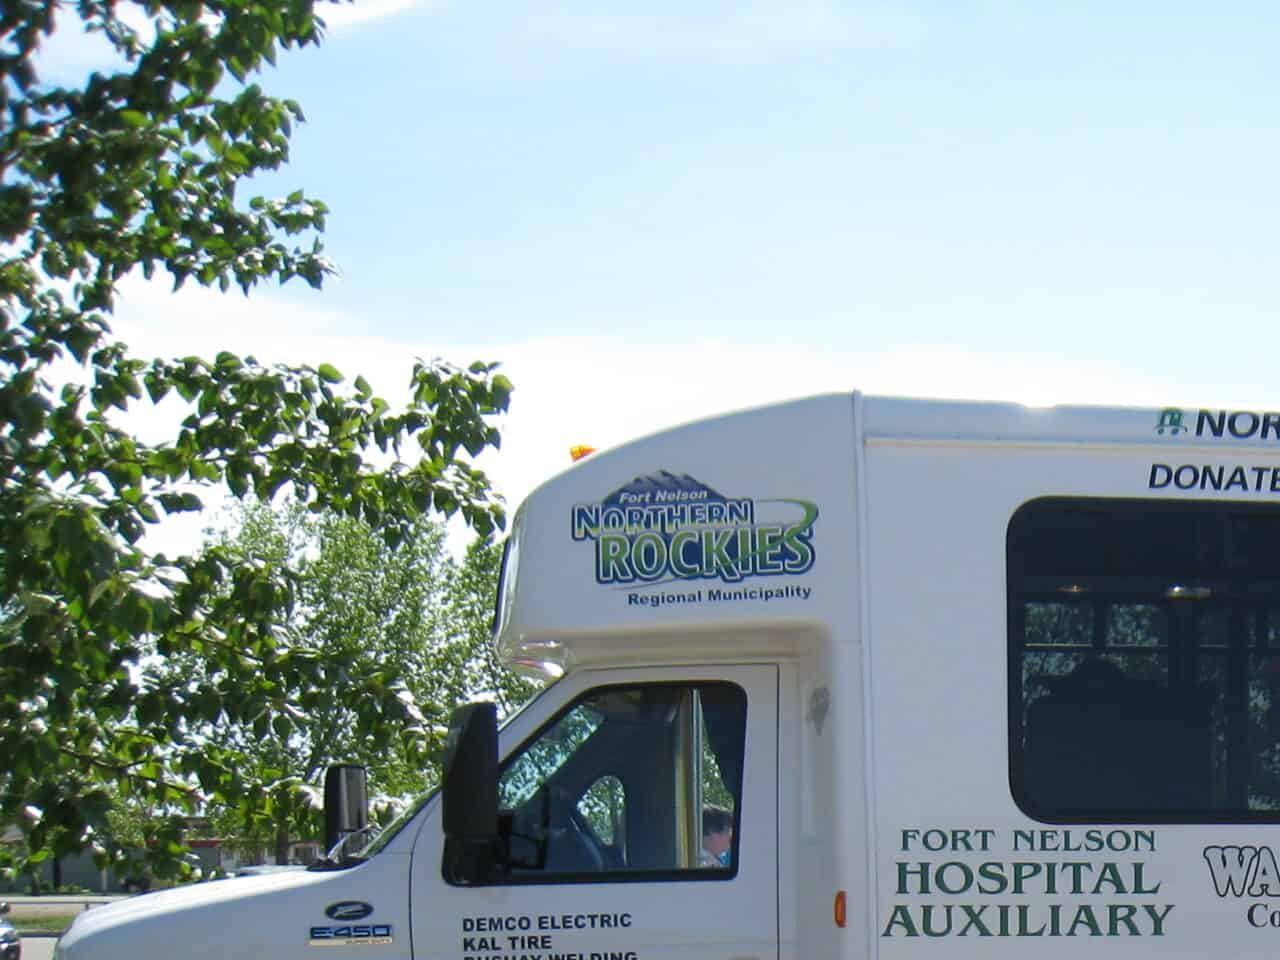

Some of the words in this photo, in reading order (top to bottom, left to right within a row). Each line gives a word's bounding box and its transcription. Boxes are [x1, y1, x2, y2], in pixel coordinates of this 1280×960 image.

[619, 491, 650, 504] Fort
[655, 489, 708, 502] Nelson
[572, 499, 754, 540] NORTHERN
[596, 524, 816, 584] ROCKIES
[628, 590, 702, 607] Regional
[707, 586, 812, 602] Municipality
[900, 829, 996, 852] FORT
[1012, 829, 1156, 852] NELSON
[895, 861, 1163, 894] HOSPITAL
[462, 916, 531, 933] DEMCO
[537, 913, 632, 930] ELECTRIC
[881, 904, 1176, 937] AUXILIARY
[463, 937, 502, 952] KAL
[508, 935, 553, 950] TIRE
